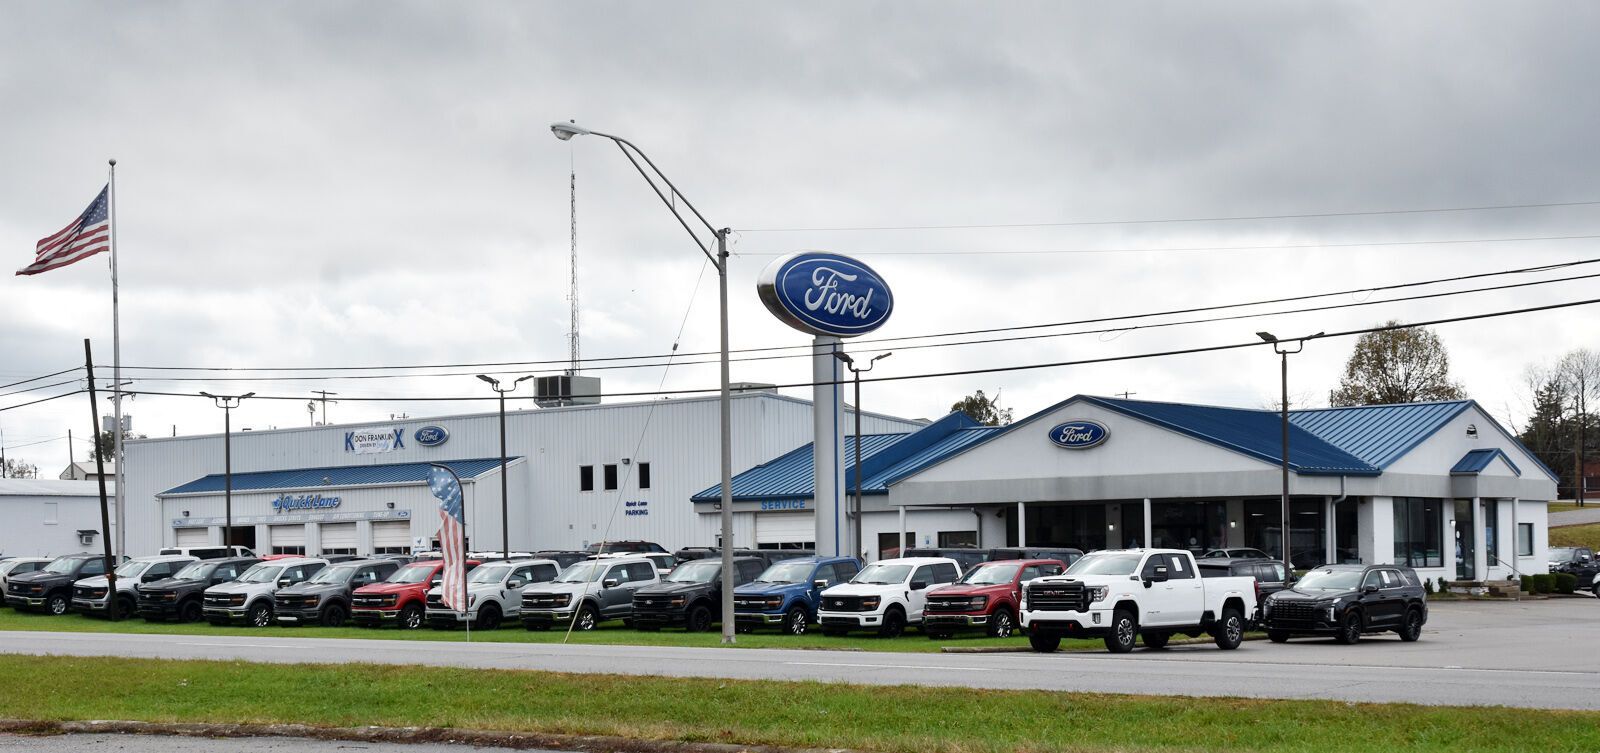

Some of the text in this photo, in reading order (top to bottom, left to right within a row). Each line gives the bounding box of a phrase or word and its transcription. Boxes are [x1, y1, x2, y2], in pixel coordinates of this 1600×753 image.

[804, 266, 874, 319] Ford
[344, 431, 355, 451] K
[393, 428, 404, 448] X
[355, 433, 393, 442] DON FRANKLIN
[420, 430, 439, 441] Ford
[1060, 426, 1094, 442] Ford
[282, 495, 339, 510] Quick Lane
[761, 499, 806, 510] SERVICE
